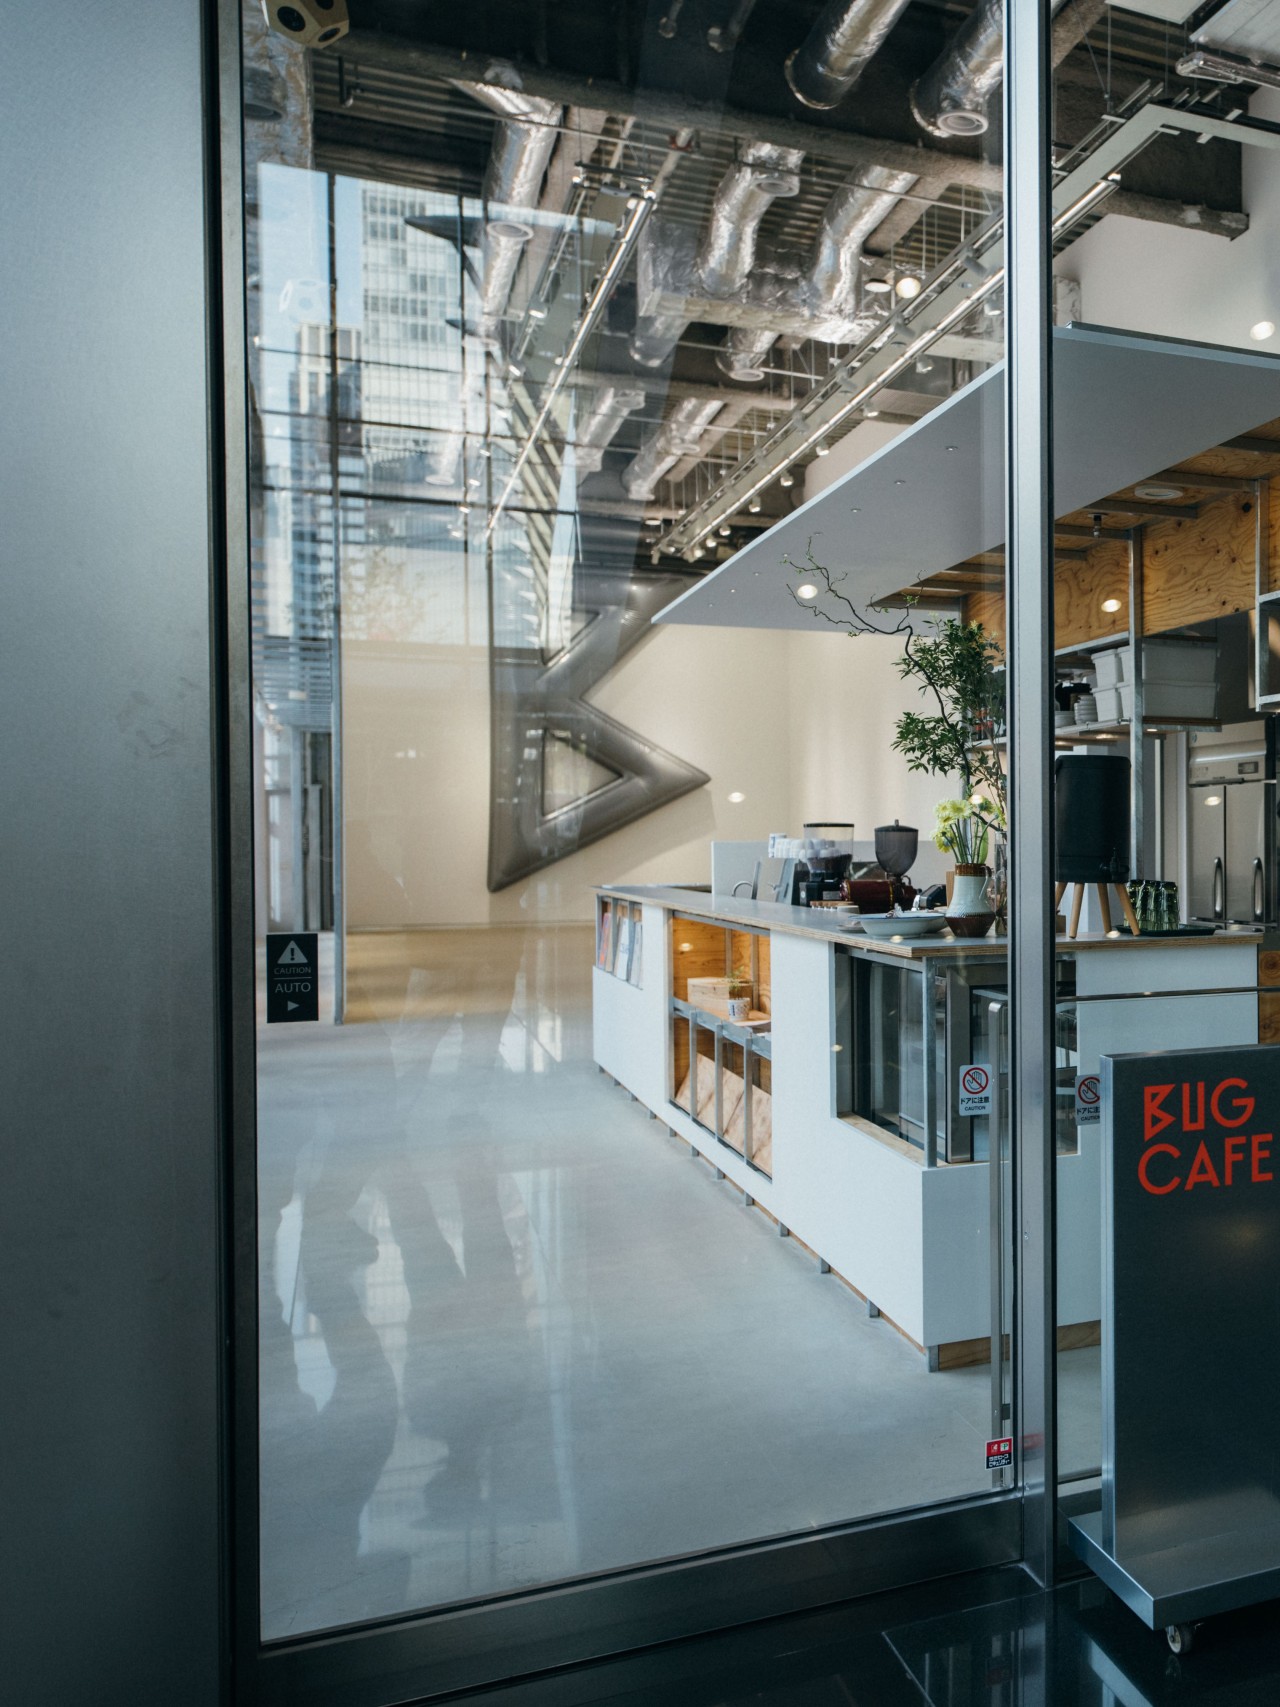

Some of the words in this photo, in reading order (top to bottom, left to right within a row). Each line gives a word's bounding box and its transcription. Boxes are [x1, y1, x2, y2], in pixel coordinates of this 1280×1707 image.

[273, 966, 312, 975] CAUTION
[275, 982, 311, 993] AUTO
[960, 1096, 990, 1105] ドアに注意
[1076, 1106, 1100, 1115] ドアに注
[1144, 1077, 1256, 1142] BUG
[1138, 1133, 1274, 1195] CAFE
